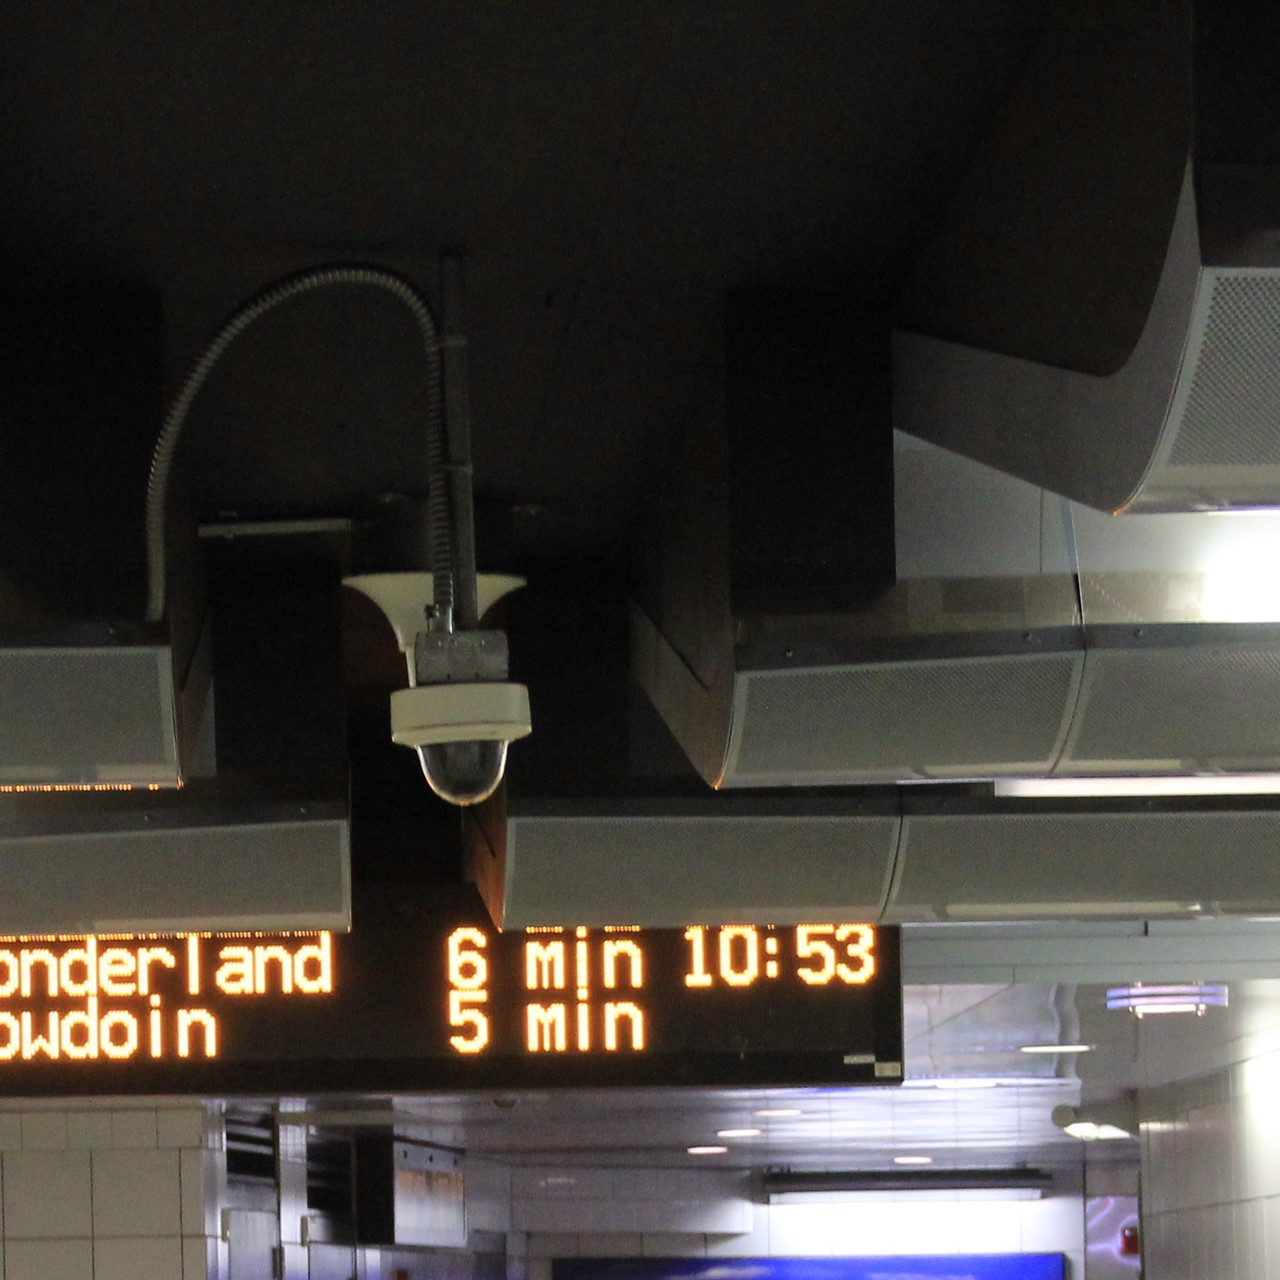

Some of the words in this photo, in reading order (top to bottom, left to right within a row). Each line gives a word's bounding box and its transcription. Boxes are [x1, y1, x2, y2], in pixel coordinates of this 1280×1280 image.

[446, 925, 489, 991] 6
[524, 925, 643, 990] min
[684, 924, 876, 987] 10:53
[448, 988, 489, 1054] 5
[525, 988, 646, 1052] min
